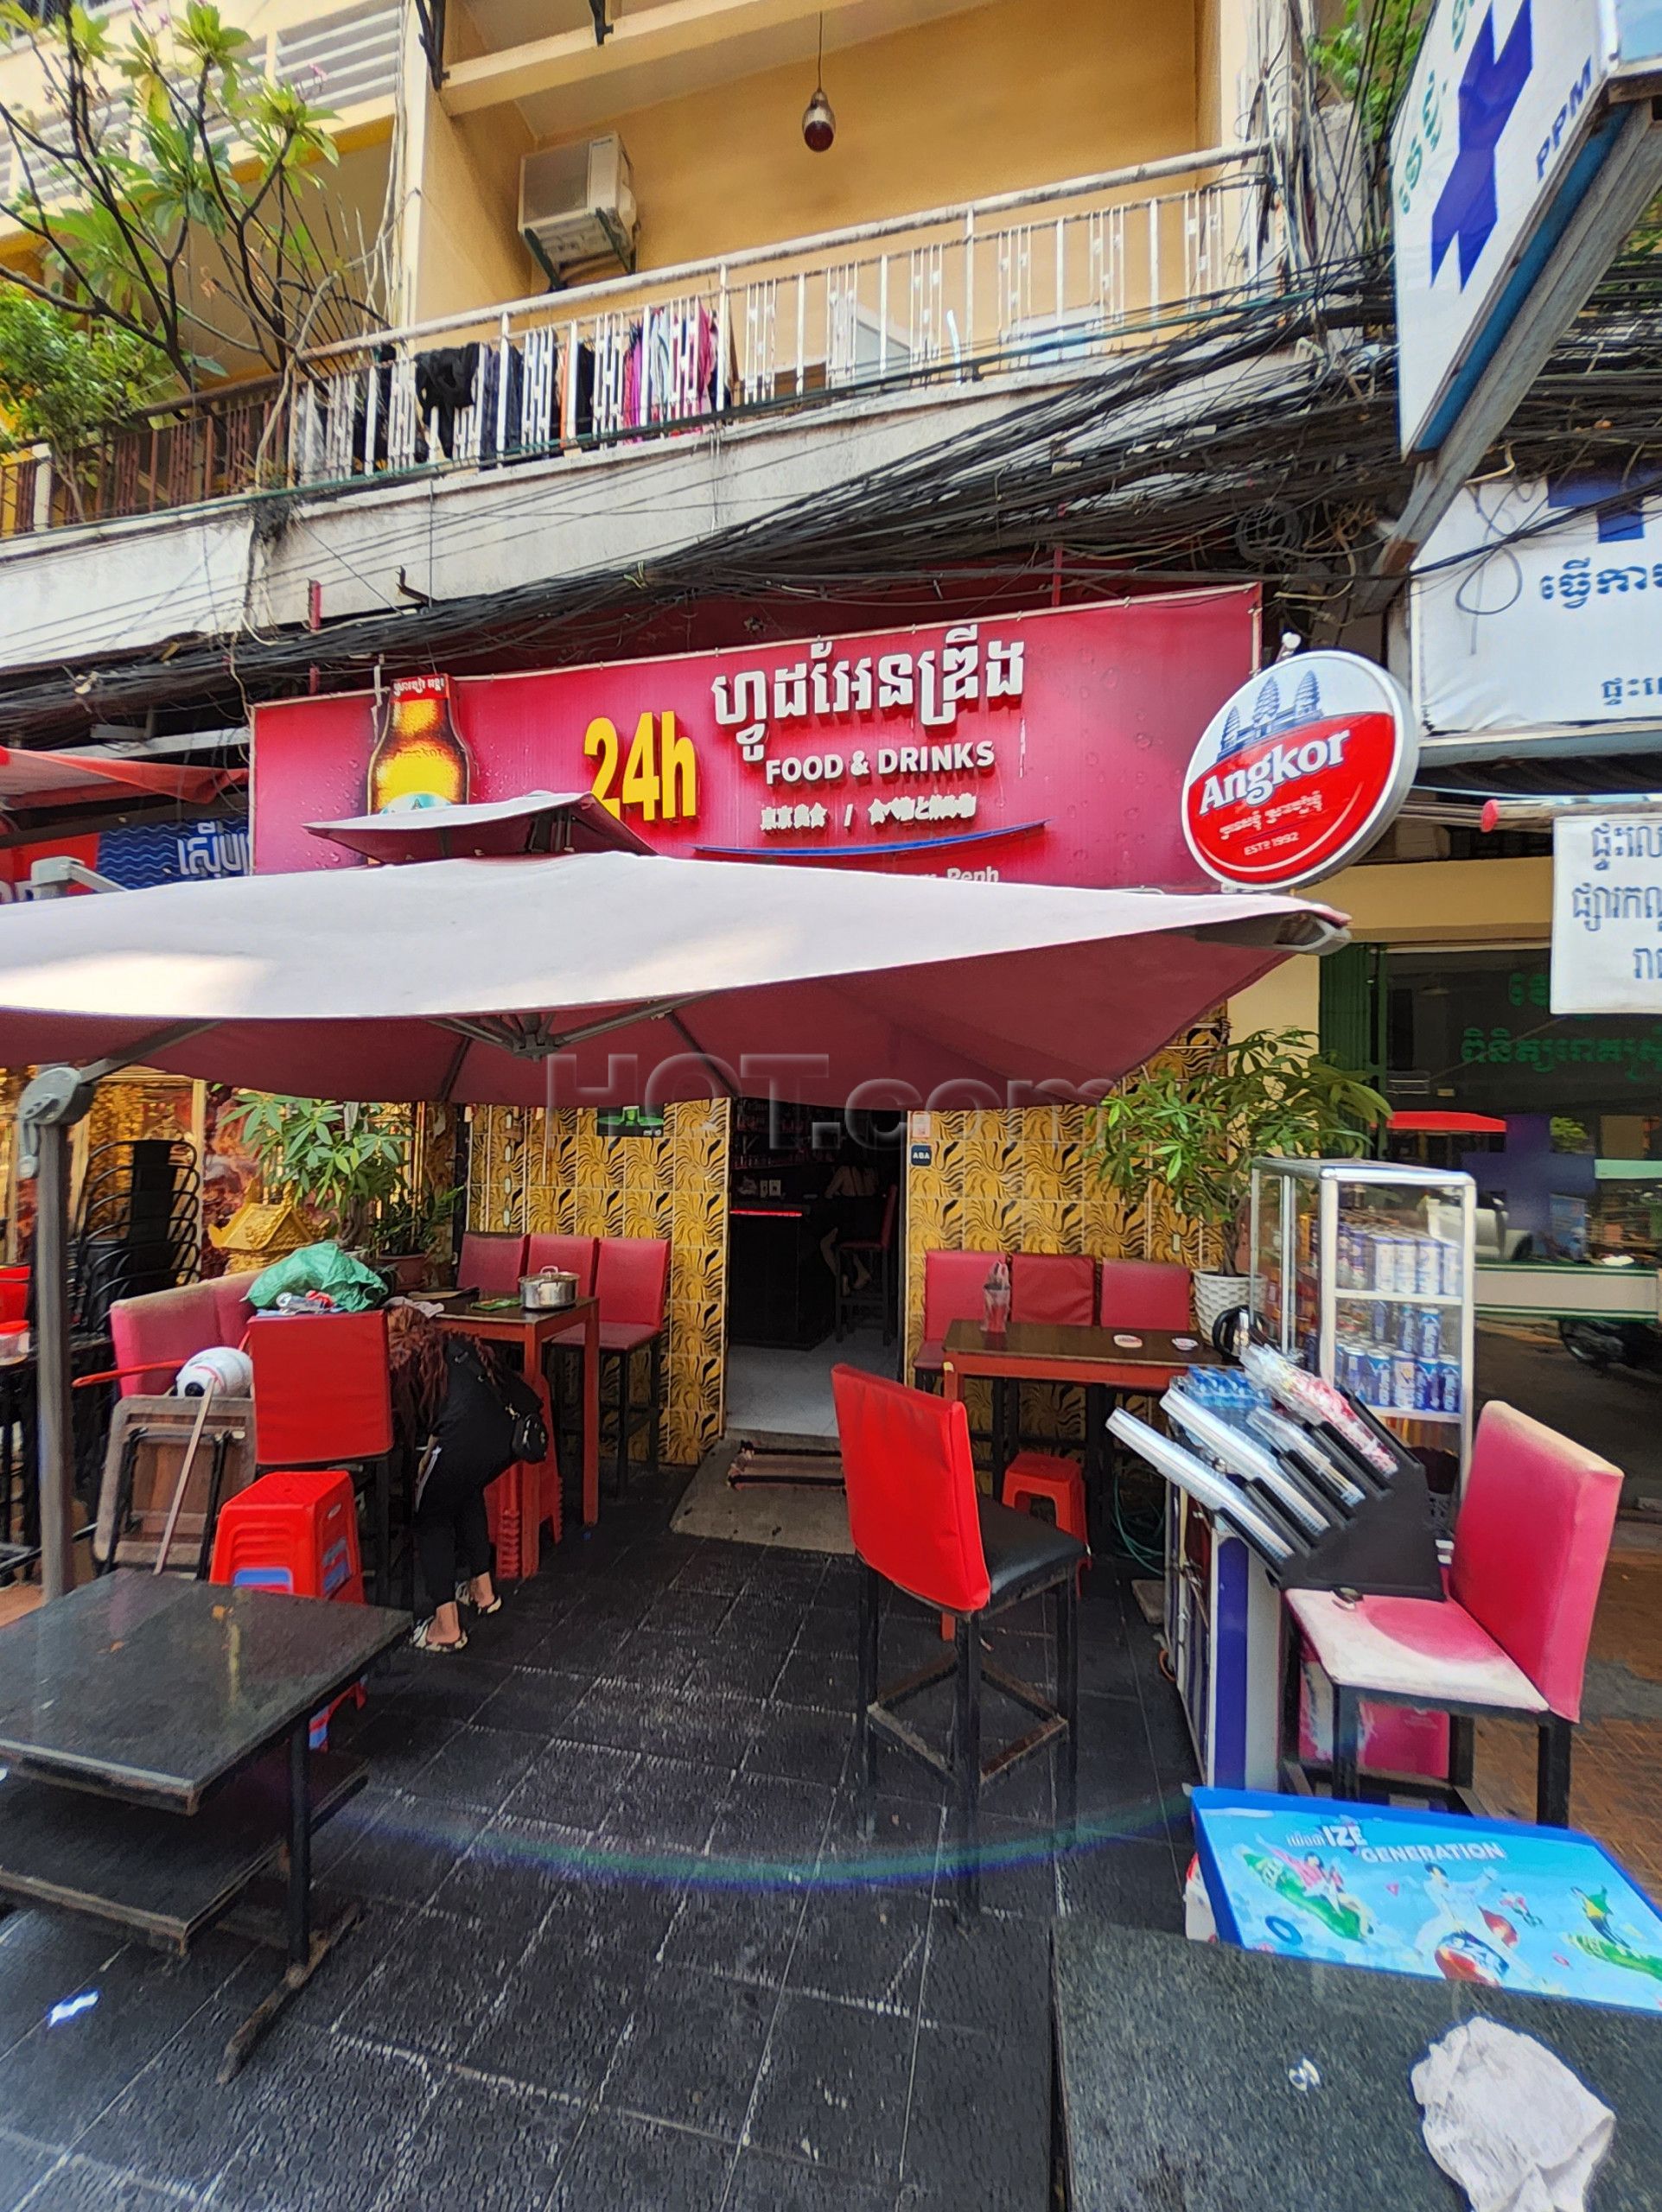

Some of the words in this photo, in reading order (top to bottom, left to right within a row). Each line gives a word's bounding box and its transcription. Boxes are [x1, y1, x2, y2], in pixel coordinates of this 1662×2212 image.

[583, 710, 699, 823] 24h
[765, 753, 844, 785] FOOD
[850, 750, 869, 777] &
[877, 740, 995, 775] DRINKS
[1199, 728, 1350, 816] Angkor
[1271, 831, 1300, 848] 1992
[947, 866, 999, 882] Penh
[1360, 1841, 1506, 1863] GENERATION
